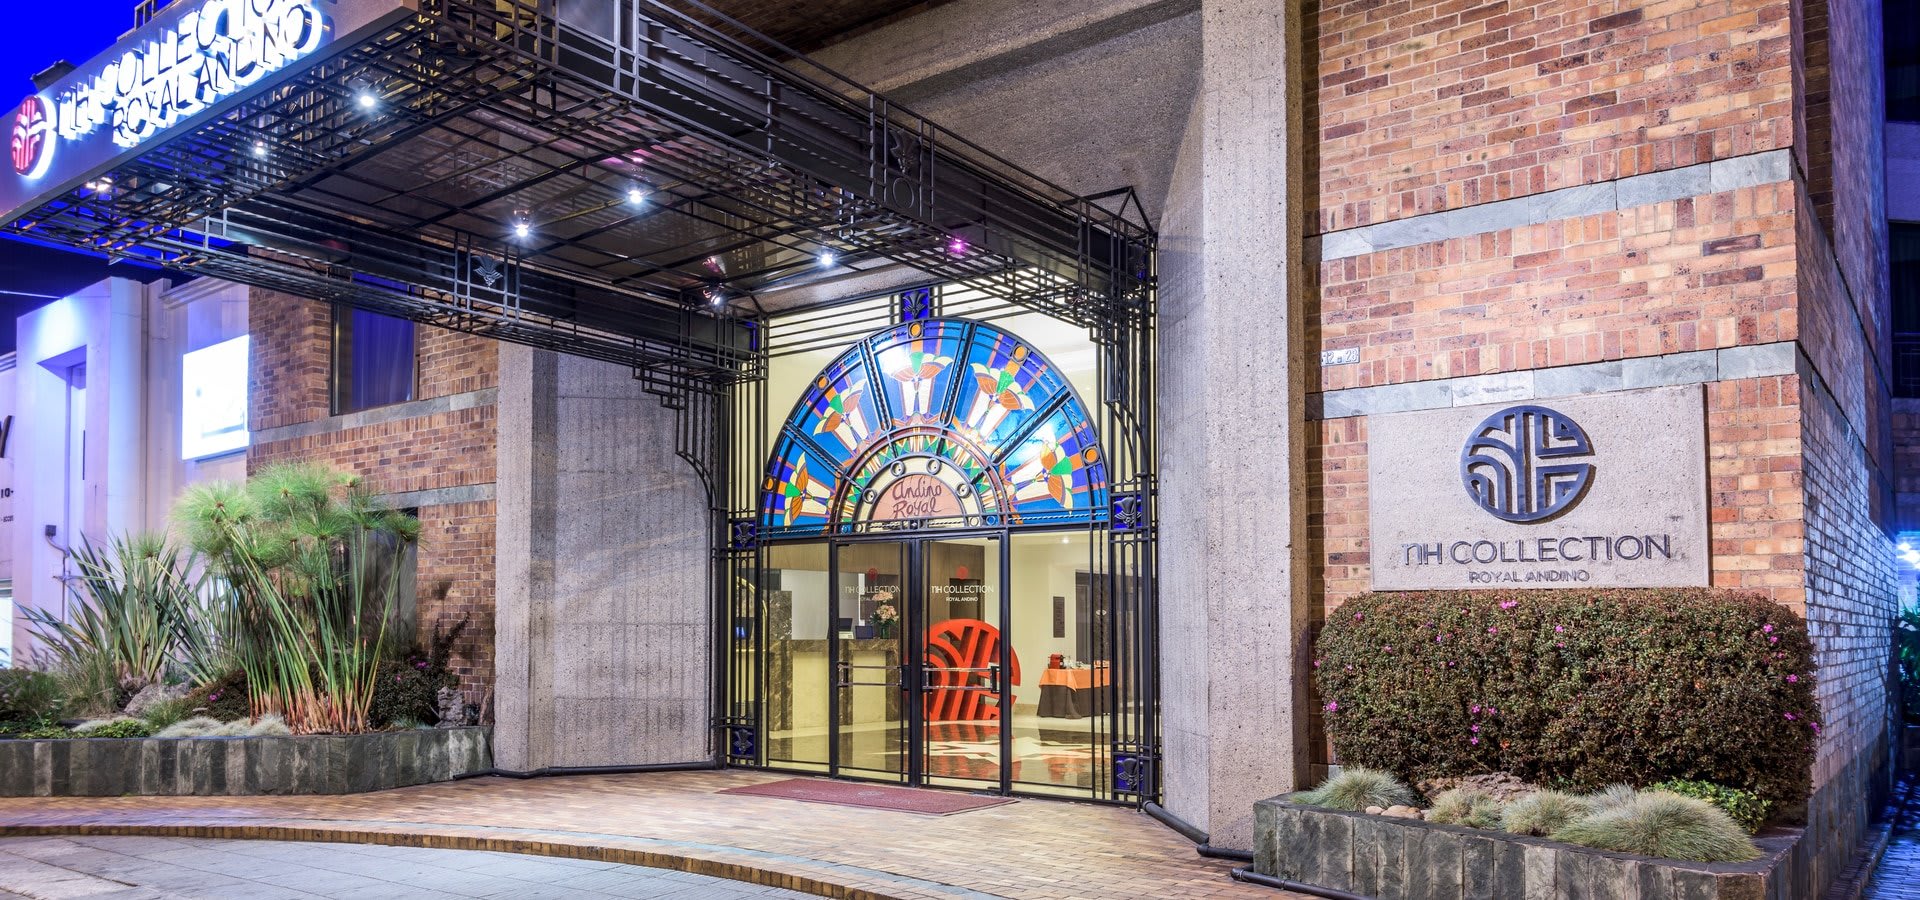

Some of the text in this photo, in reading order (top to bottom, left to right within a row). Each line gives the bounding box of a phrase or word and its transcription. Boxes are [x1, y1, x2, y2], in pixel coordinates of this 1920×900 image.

[112, 72, 205, 147] ROYAL
[892, 496, 942, 519] Royal
[1450, 533, 1671, 565] COLLECTION
[1468, 569, 1591, 584] ROYAL ANDINO
[943, 584, 994, 594] COLLECTION
